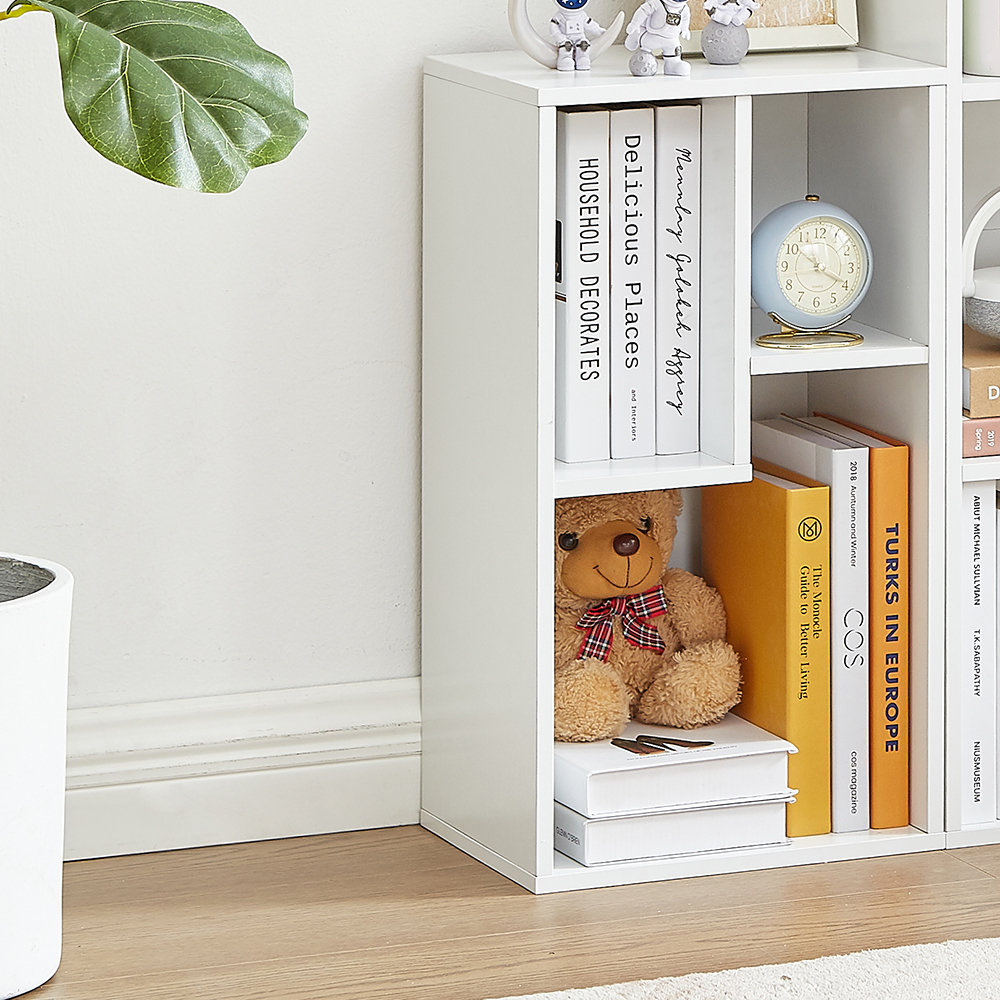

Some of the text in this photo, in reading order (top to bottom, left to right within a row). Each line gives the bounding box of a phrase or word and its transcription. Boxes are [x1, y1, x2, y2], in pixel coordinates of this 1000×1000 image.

[798, 231, 809, 243] 11
[814, 227, 827, 239] 12
[625, 136, 642, 368] Delicious Places
[785, 243, 799, 255] 10
[579, 159, 599, 380] HOUSEHOLD DECORATES
[780, 260, 789, 272] 9
[847, 262, 855, 274] 3
[785, 279, 793, 290] 8
[841, 279, 849, 291] 4
[797, 291, 805, 302] 7
[812, 296, 821, 308] 6
[830, 292, 837, 304] 5
[974, 428, 983, 451] Spring
[987, 430, 995, 447] 2019
[849, 460, 858, 482] 2018
[850, 522, 858, 539] and
[812, 563, 823, 639] The Monocle
[798, 565, 811, 701] Guide to Better Living
[843, 607, 864, 669] COS
[886, 523, 899, 752] TURKS IN EUROPE
[849, 750, 858, 815] cos magazine
